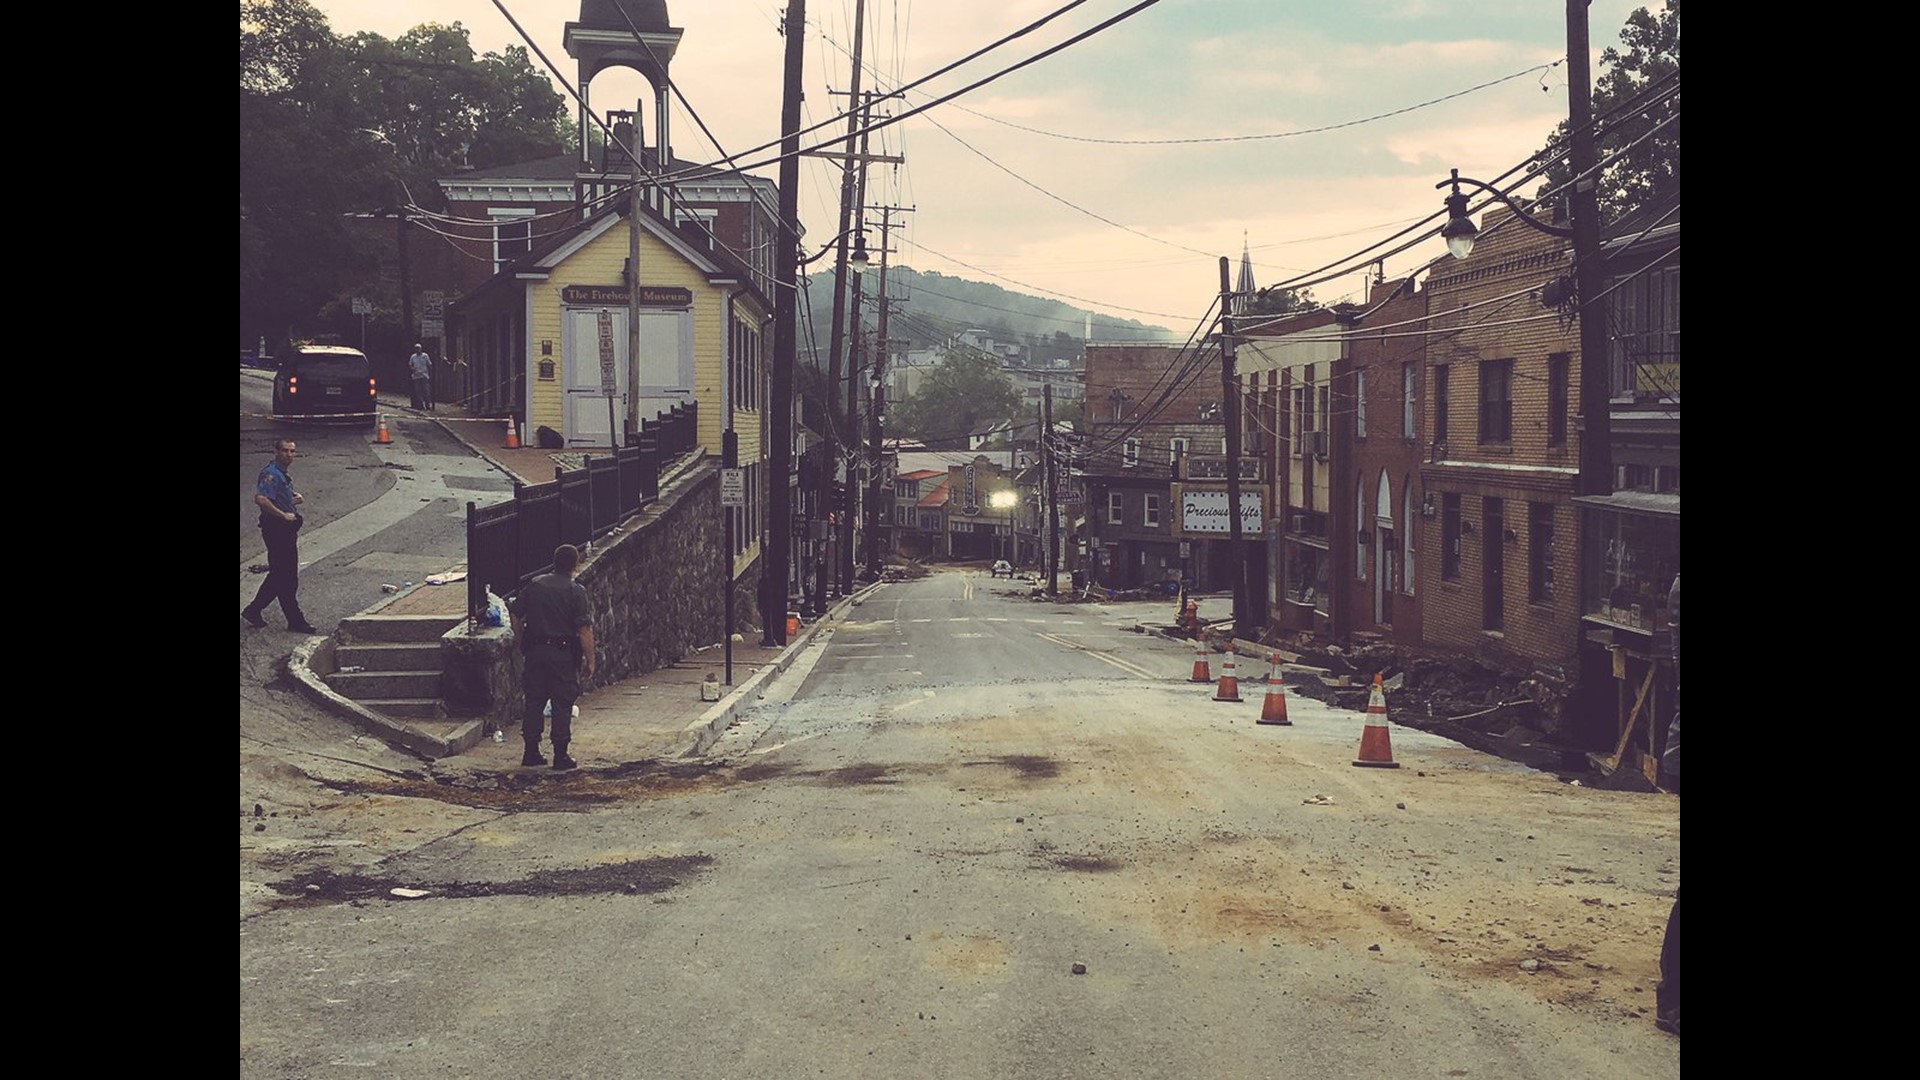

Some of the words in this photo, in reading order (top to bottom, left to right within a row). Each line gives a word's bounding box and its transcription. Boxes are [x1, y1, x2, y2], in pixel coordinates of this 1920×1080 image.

[568, 290, 588, 300] The
[592, 290, 631, 300] Firehou
[644, 291, 687, 301] Museum
[425, 304, 442, 316] 25
[1185, 503, 1229, 517] Precious
[1239, 504, 1260, 521] ifts
